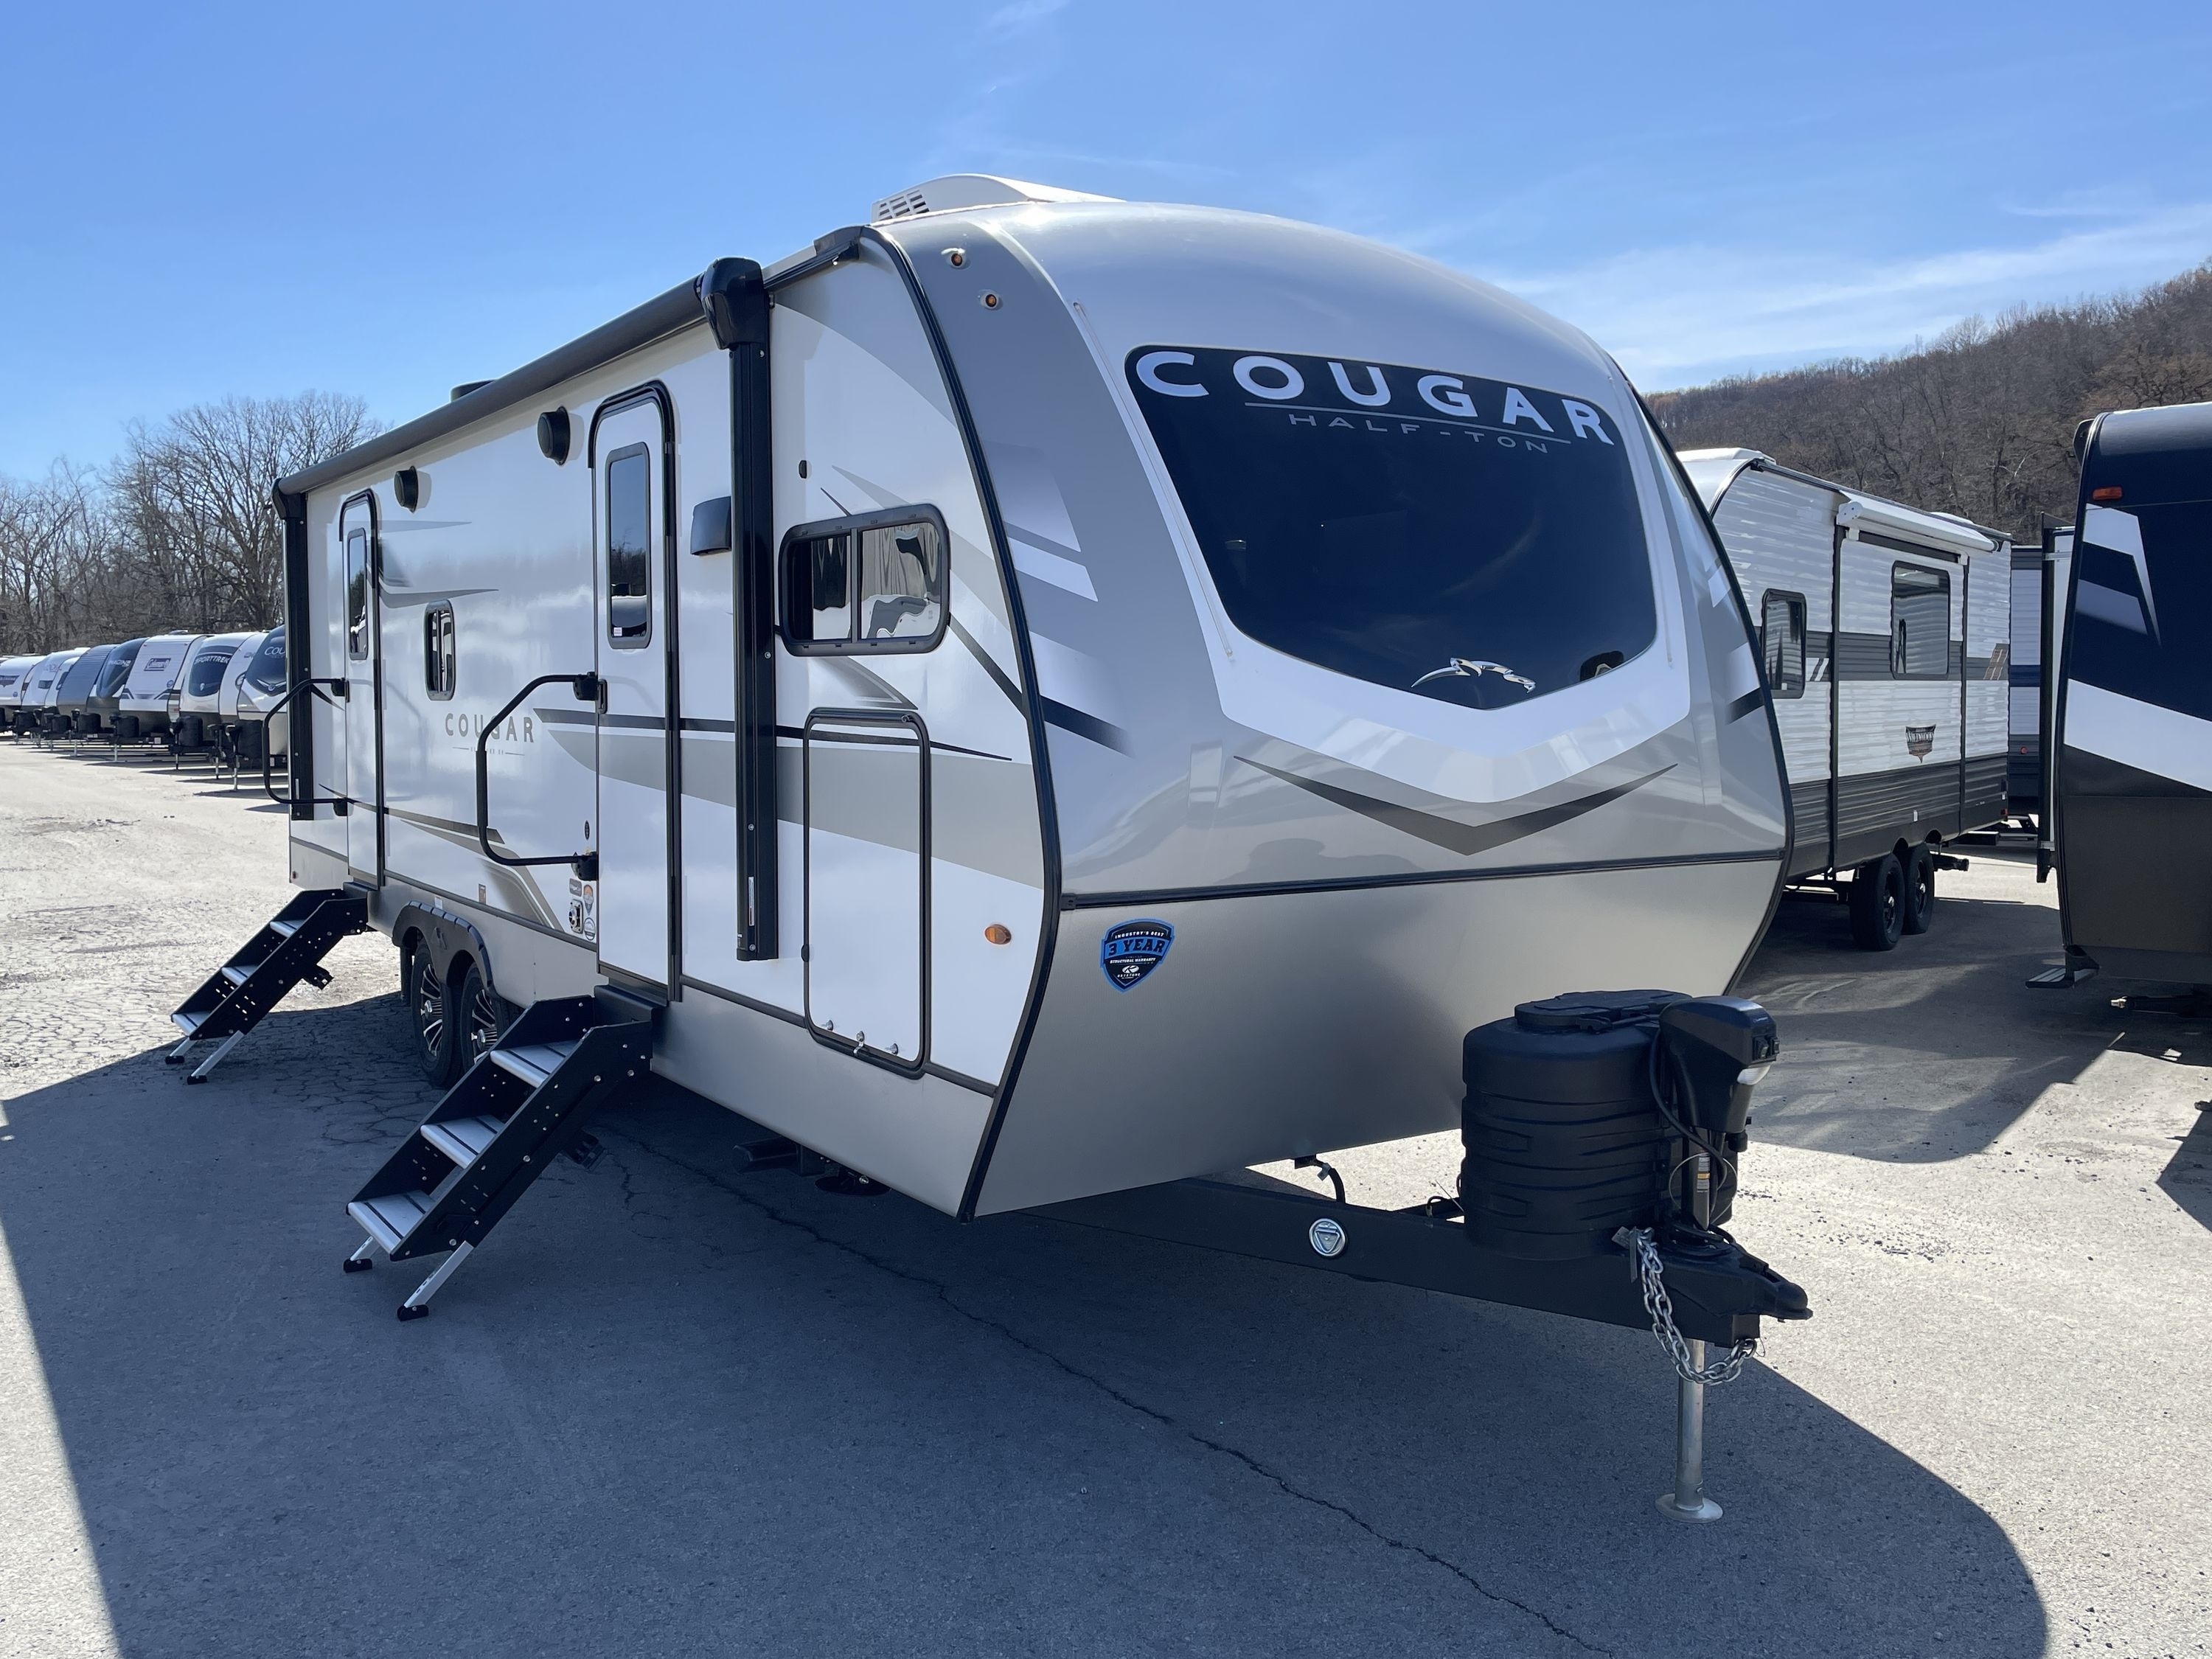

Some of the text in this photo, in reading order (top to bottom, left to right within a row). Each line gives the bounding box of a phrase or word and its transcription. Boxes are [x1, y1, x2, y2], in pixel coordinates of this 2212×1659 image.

[1135, 350, 1615, 445] COUGAR
[1289, 414, 1548, 453] HALF-TON
[1108, 939, 1165, 956] 3 YEAR
